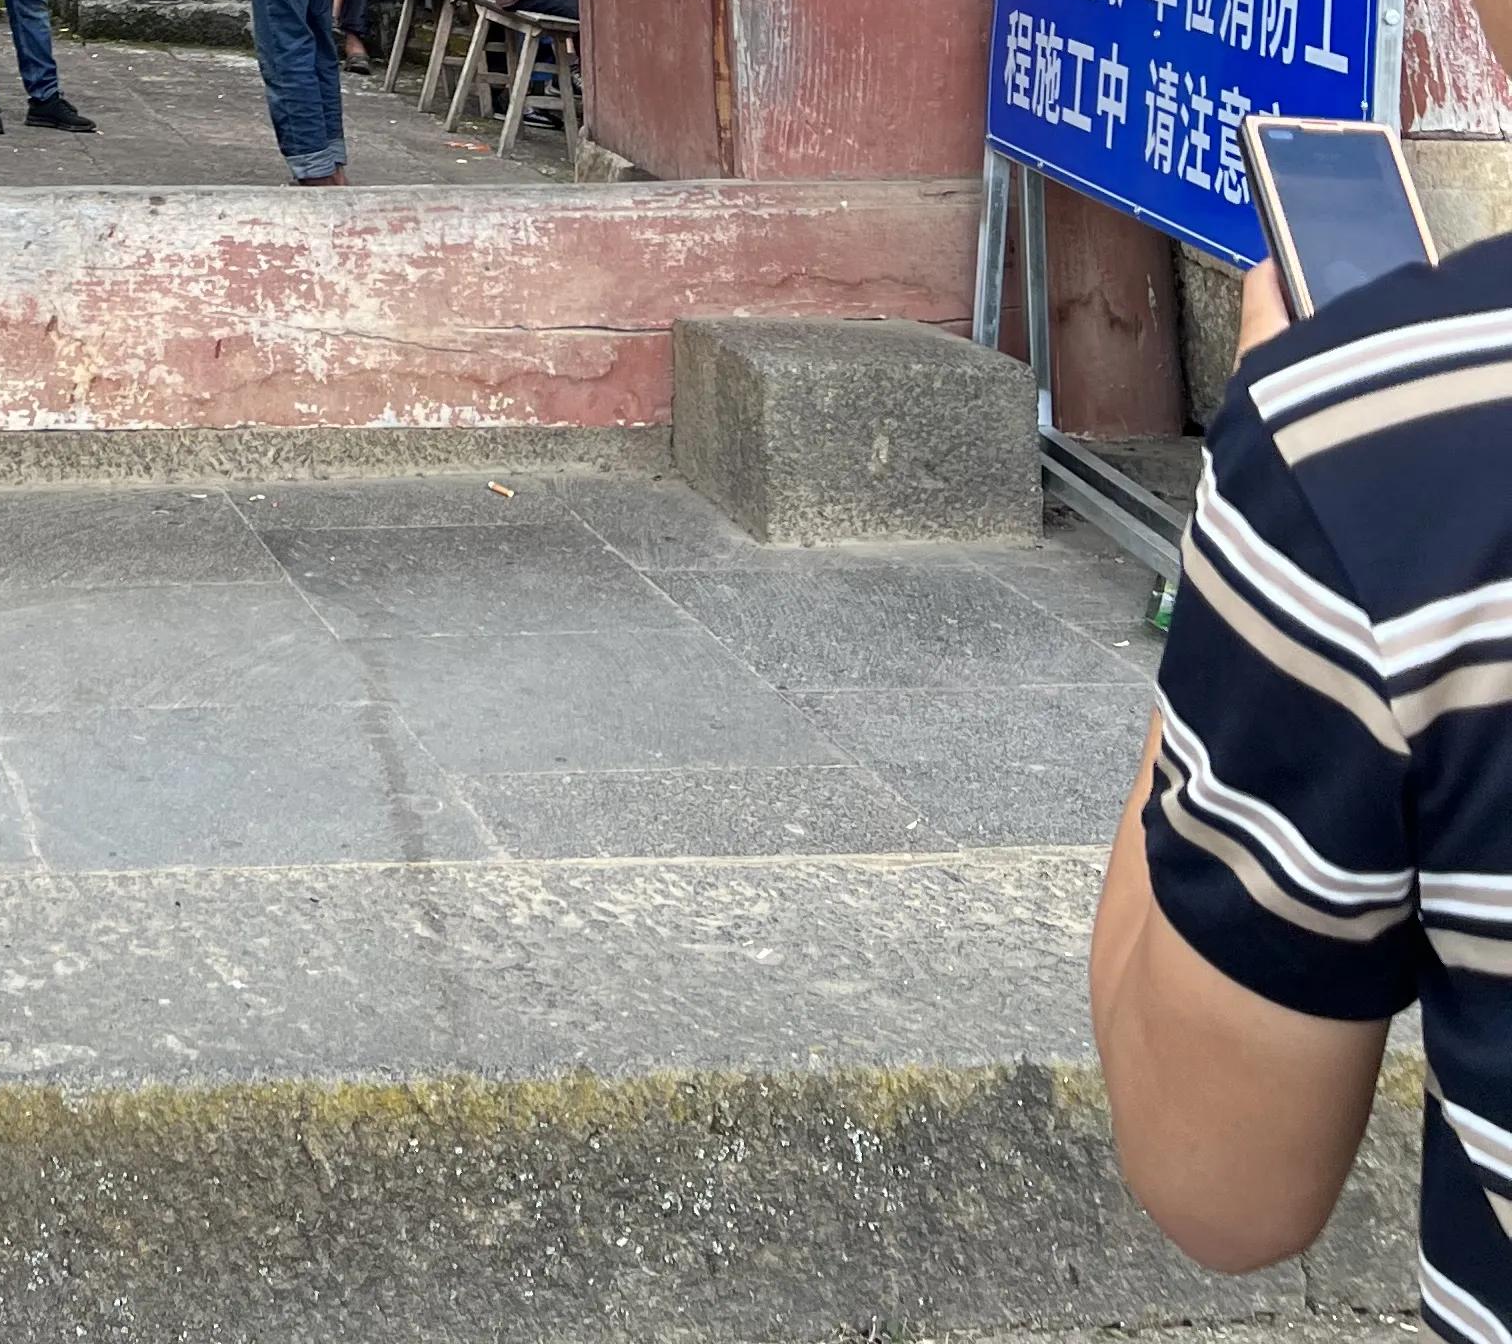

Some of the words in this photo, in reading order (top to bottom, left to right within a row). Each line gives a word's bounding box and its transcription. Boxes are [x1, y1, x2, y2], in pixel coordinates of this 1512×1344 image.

[1004, 9, 1129, 149] 程施工中
[1145, 59, 1281, 205] 请注意
